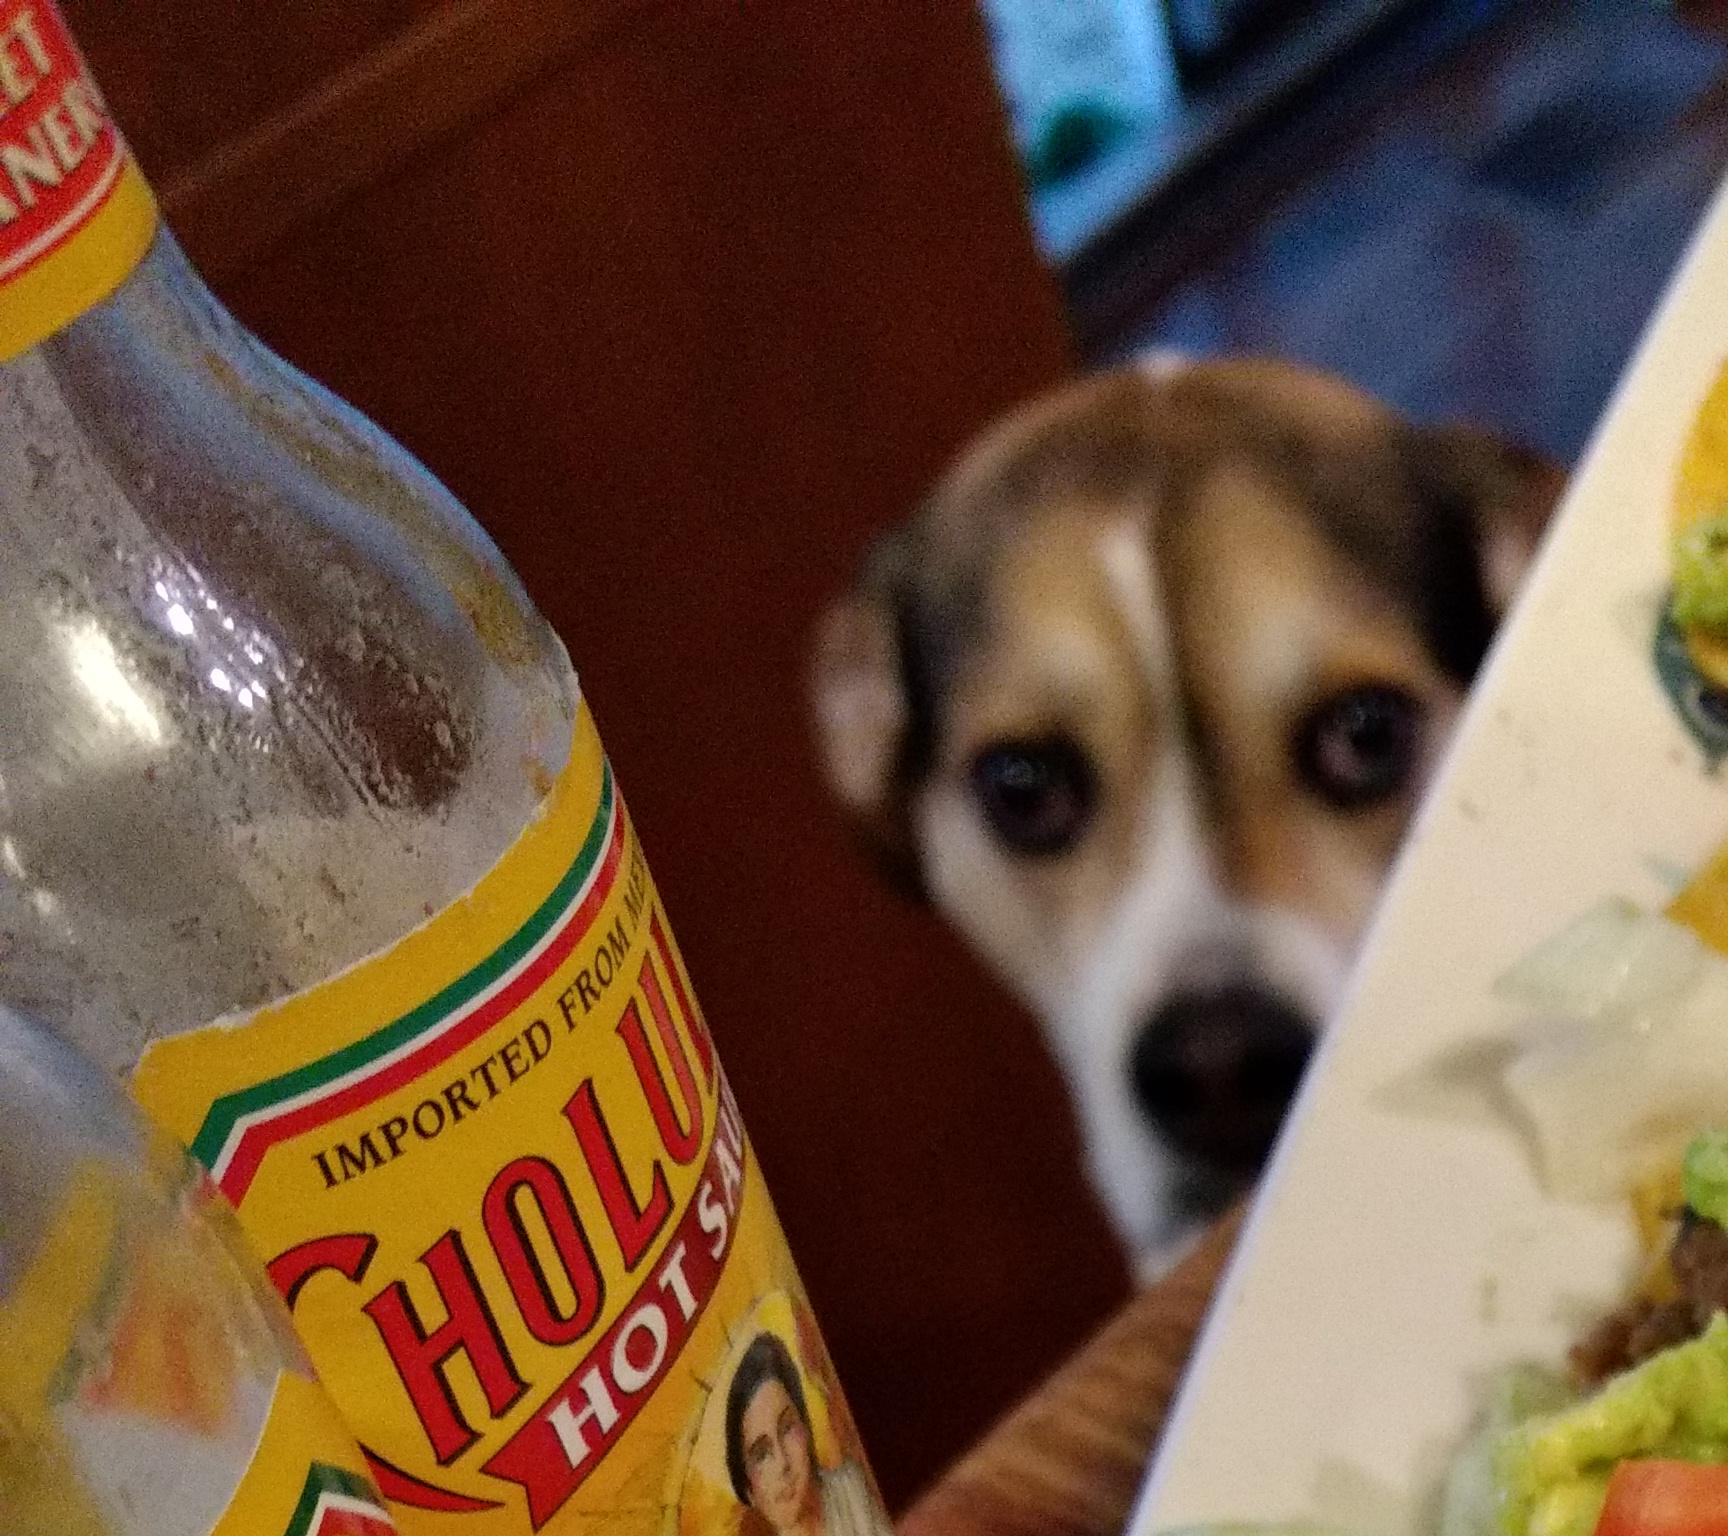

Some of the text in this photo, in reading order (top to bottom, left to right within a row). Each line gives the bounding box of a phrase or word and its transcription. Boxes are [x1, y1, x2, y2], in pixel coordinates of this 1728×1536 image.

[311, 1020, 553, 1190] IMPORTED
[556, 914, 631, 1035] FROM
[547, 1248, 699, 1471] HOT
